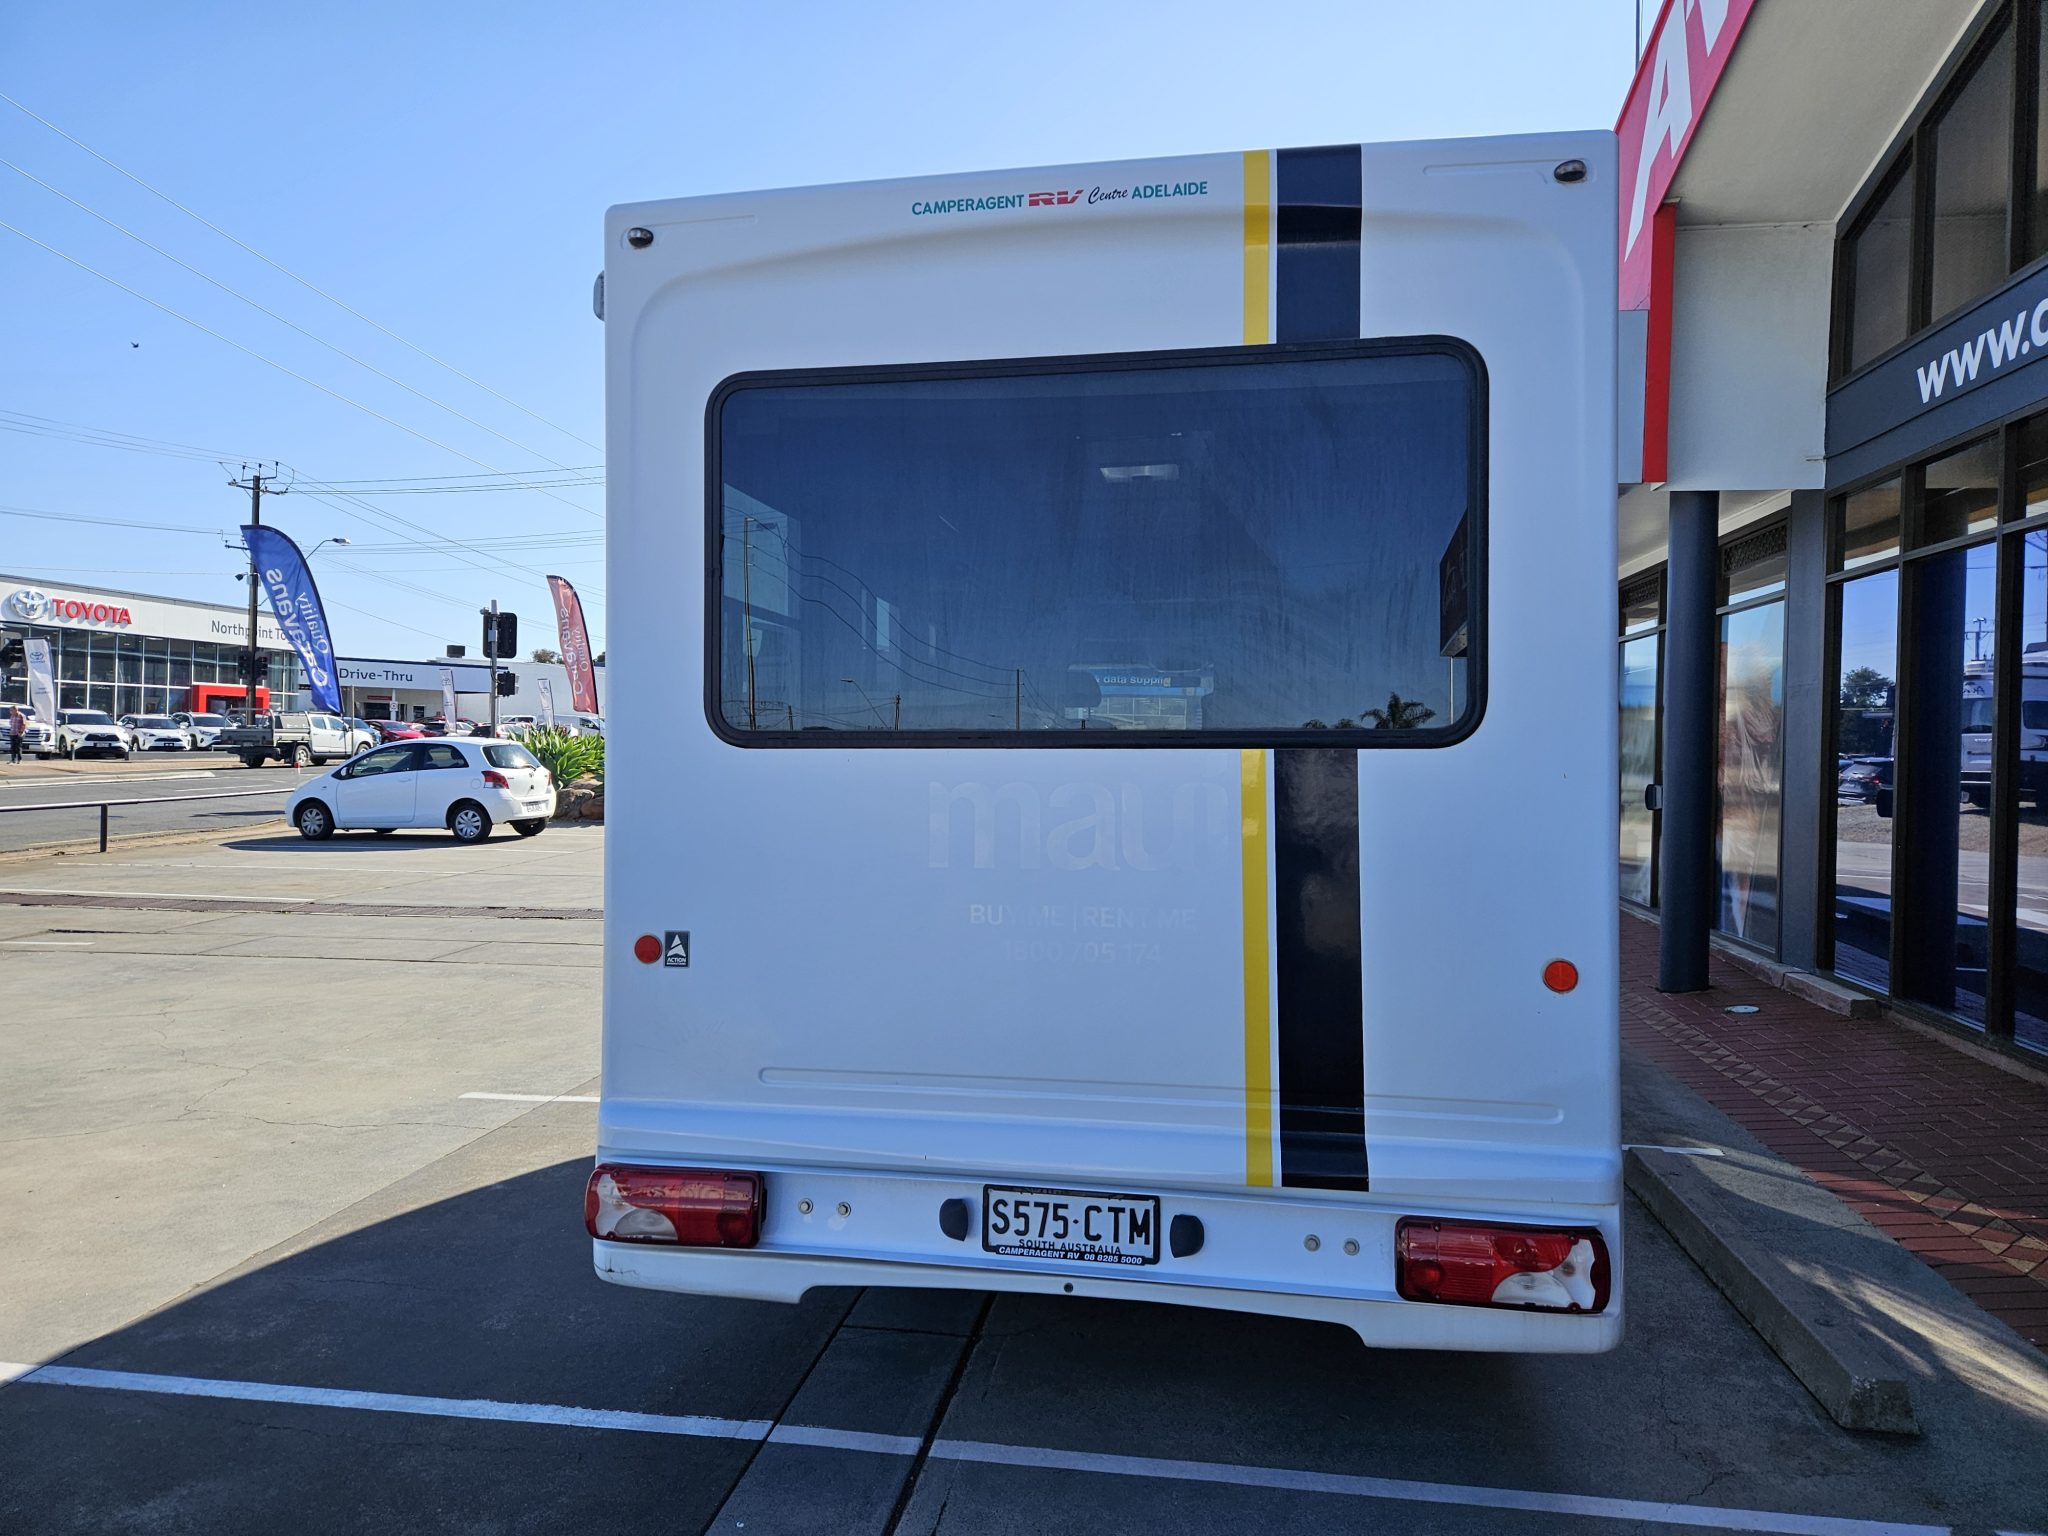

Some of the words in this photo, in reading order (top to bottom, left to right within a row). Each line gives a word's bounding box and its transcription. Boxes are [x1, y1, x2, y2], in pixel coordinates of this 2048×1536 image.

[912, 194, 1025, 216] CAMPERAGENT
[1028, 189, 1084, 207] RV
[1087, 186, 1129, 205] Centre
[1131, 181, 1208, 199] ADELAIDE
[52, 598, 132, 625] TOYOTA
[211, 620, 273, 640] Northpint
[339, 668, 413, 682] Drive-Thru
[998, 1246, 1066, 1260] CAMPERAGENT
[1067, 1252, 1080, 1260] RV
[1084, 1253, 1095, 1261] 08
[1097, 1254, 1118, 1263] 8285
[1120, 1256, 1143, 1265] 5000
[1019, 1238, 1056, 1250] SOUTH
[1060, 1241, 1122, 1255] AUSTRALIA
